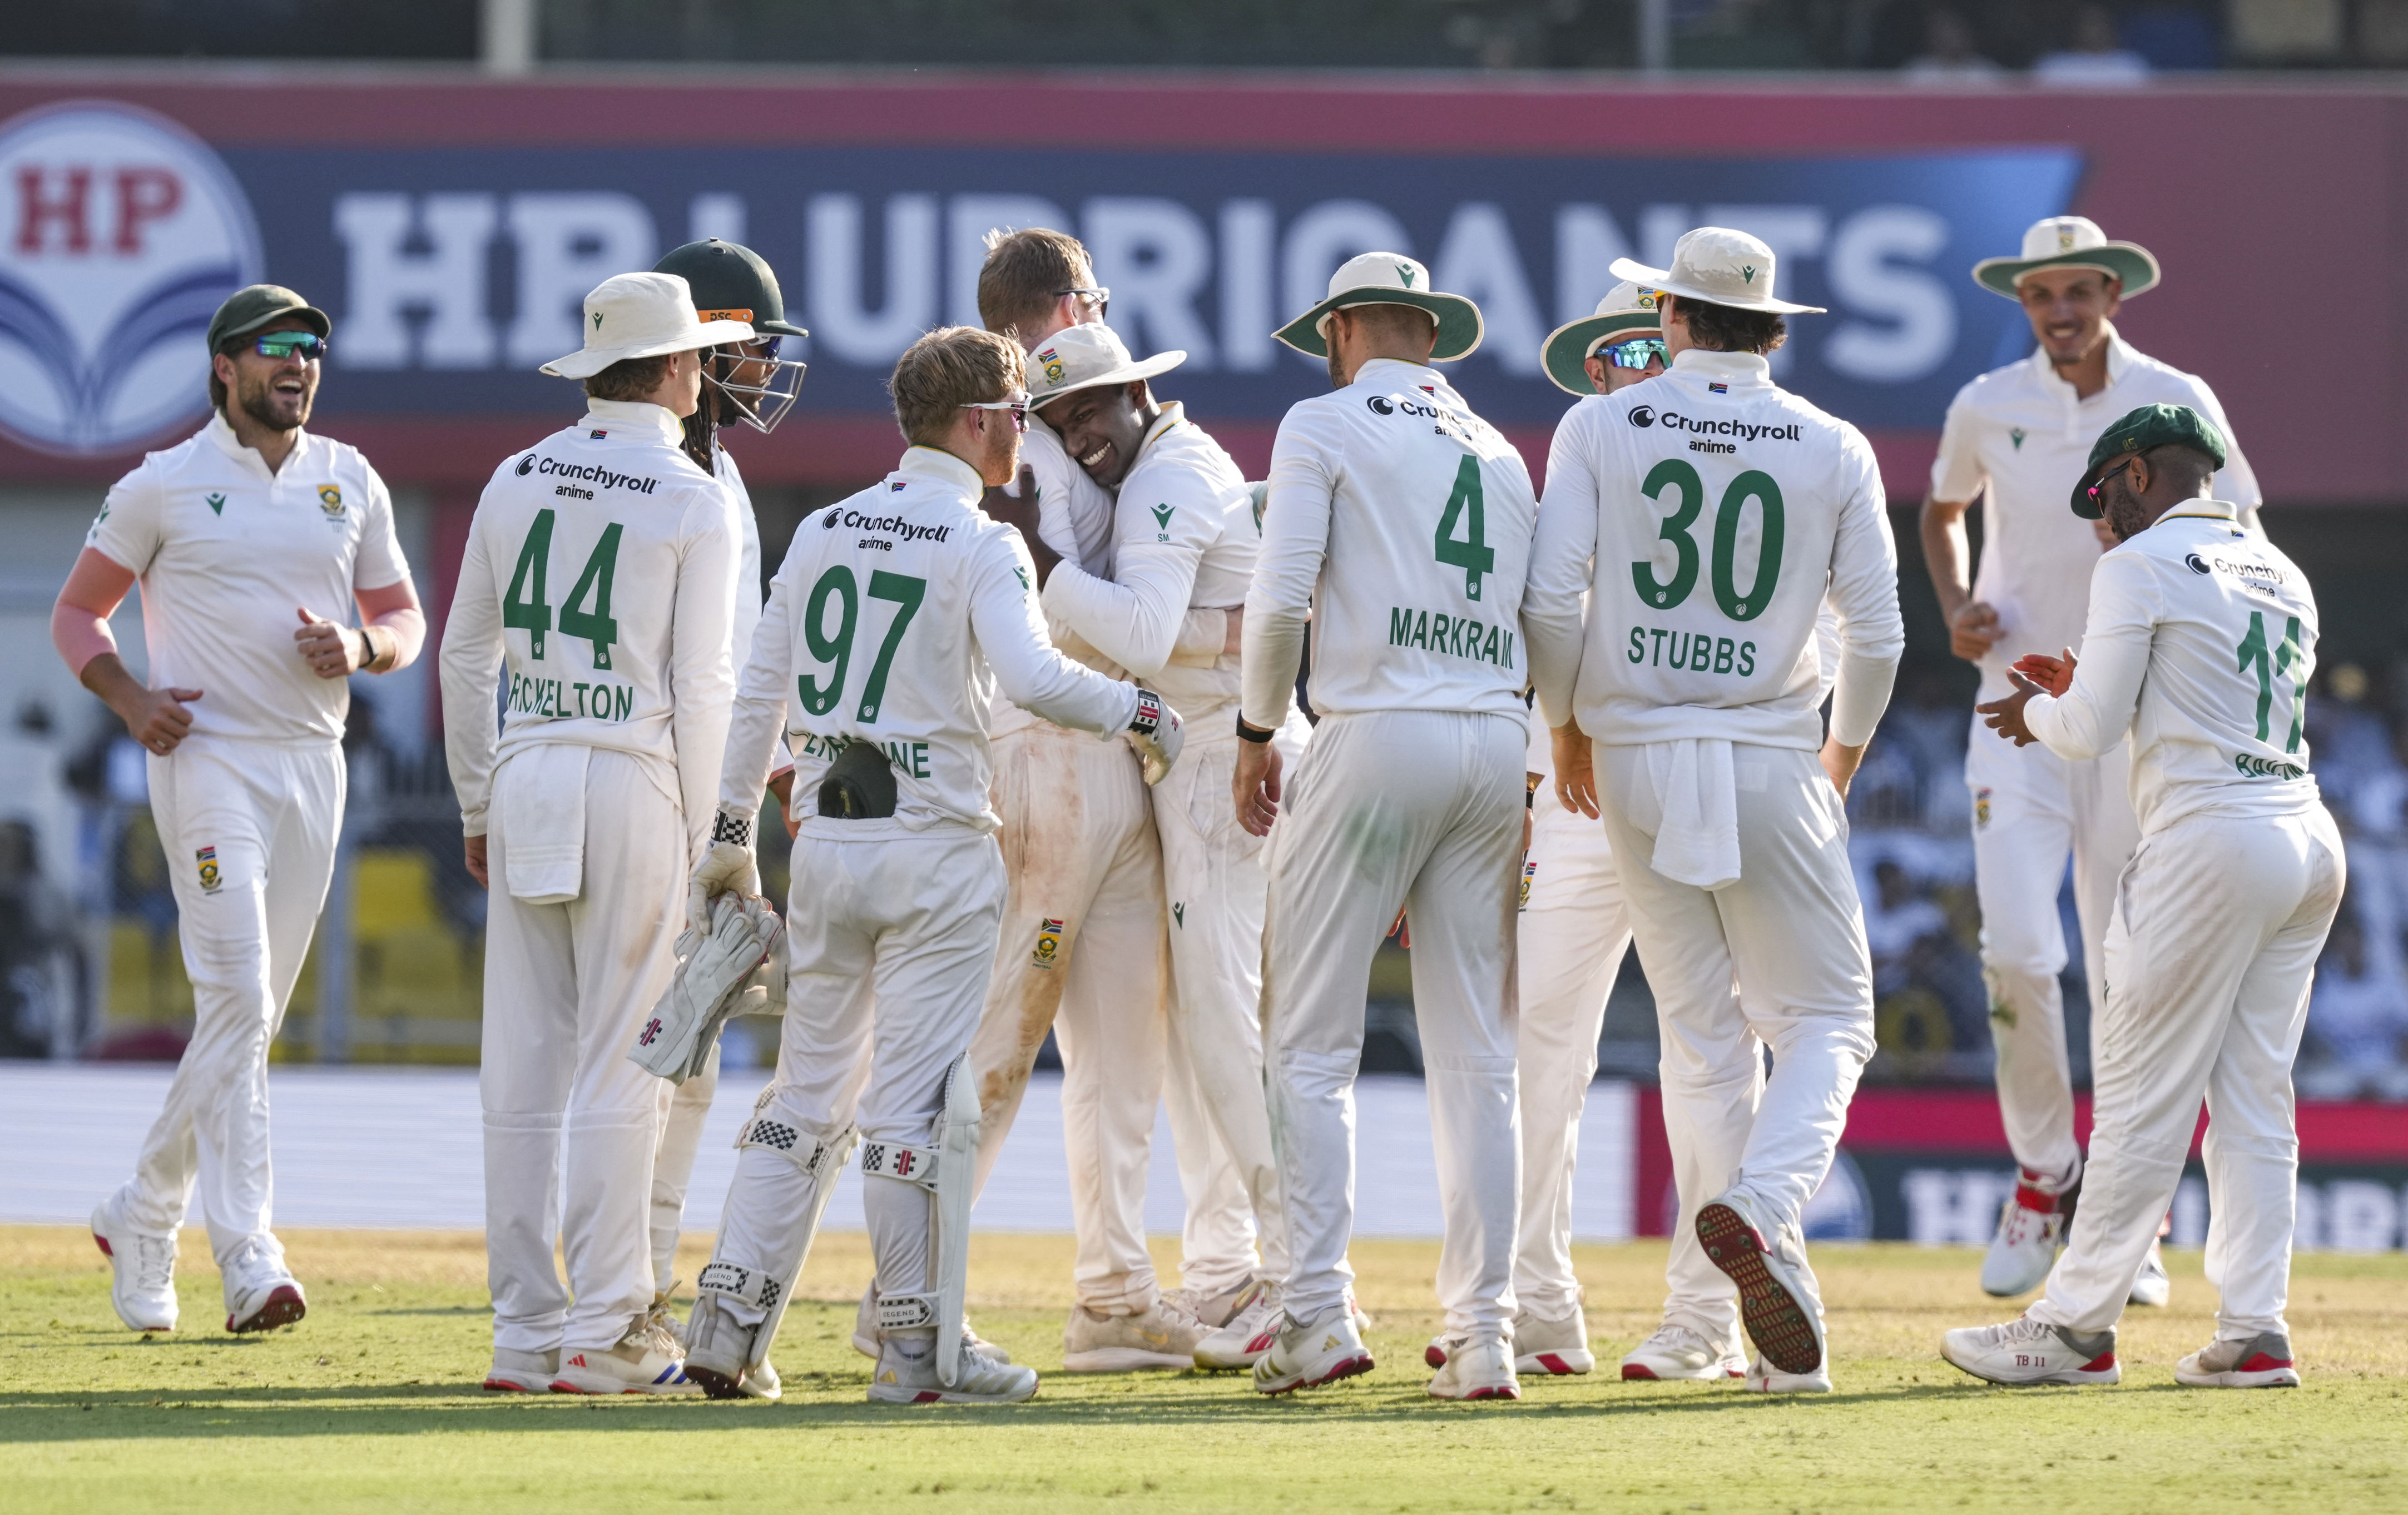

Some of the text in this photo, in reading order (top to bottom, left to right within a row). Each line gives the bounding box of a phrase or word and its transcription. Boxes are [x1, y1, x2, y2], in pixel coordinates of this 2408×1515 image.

[15, 166, 184, 256] HP
[335, 192, 657, 371] HP
[1661, 413, 1800, 441] Crunchyroll
[2122, 438, 2138, 450] 85
[1688, 439, 1736, 454] anime
[539, 457, 657, 494] Crunchyroll
[556, 484, 594, 500] anime
[844, 510, 950, 543] Crunchyroll
[1158, 533, 1170, 542] SM
[1434, 454, 1495, 602] 4
[1632, 458, 1785, 622] 30
[503, 508, 624, 670] 44
[2243, 583, 2276, 598] anime
[798, 565, 927, 724] 97
[1627, 625, 1757, 677] STUBBS
[2237, 611, 2306, 755] 11
[2015, 1354, 2046, 1367] TB 11
